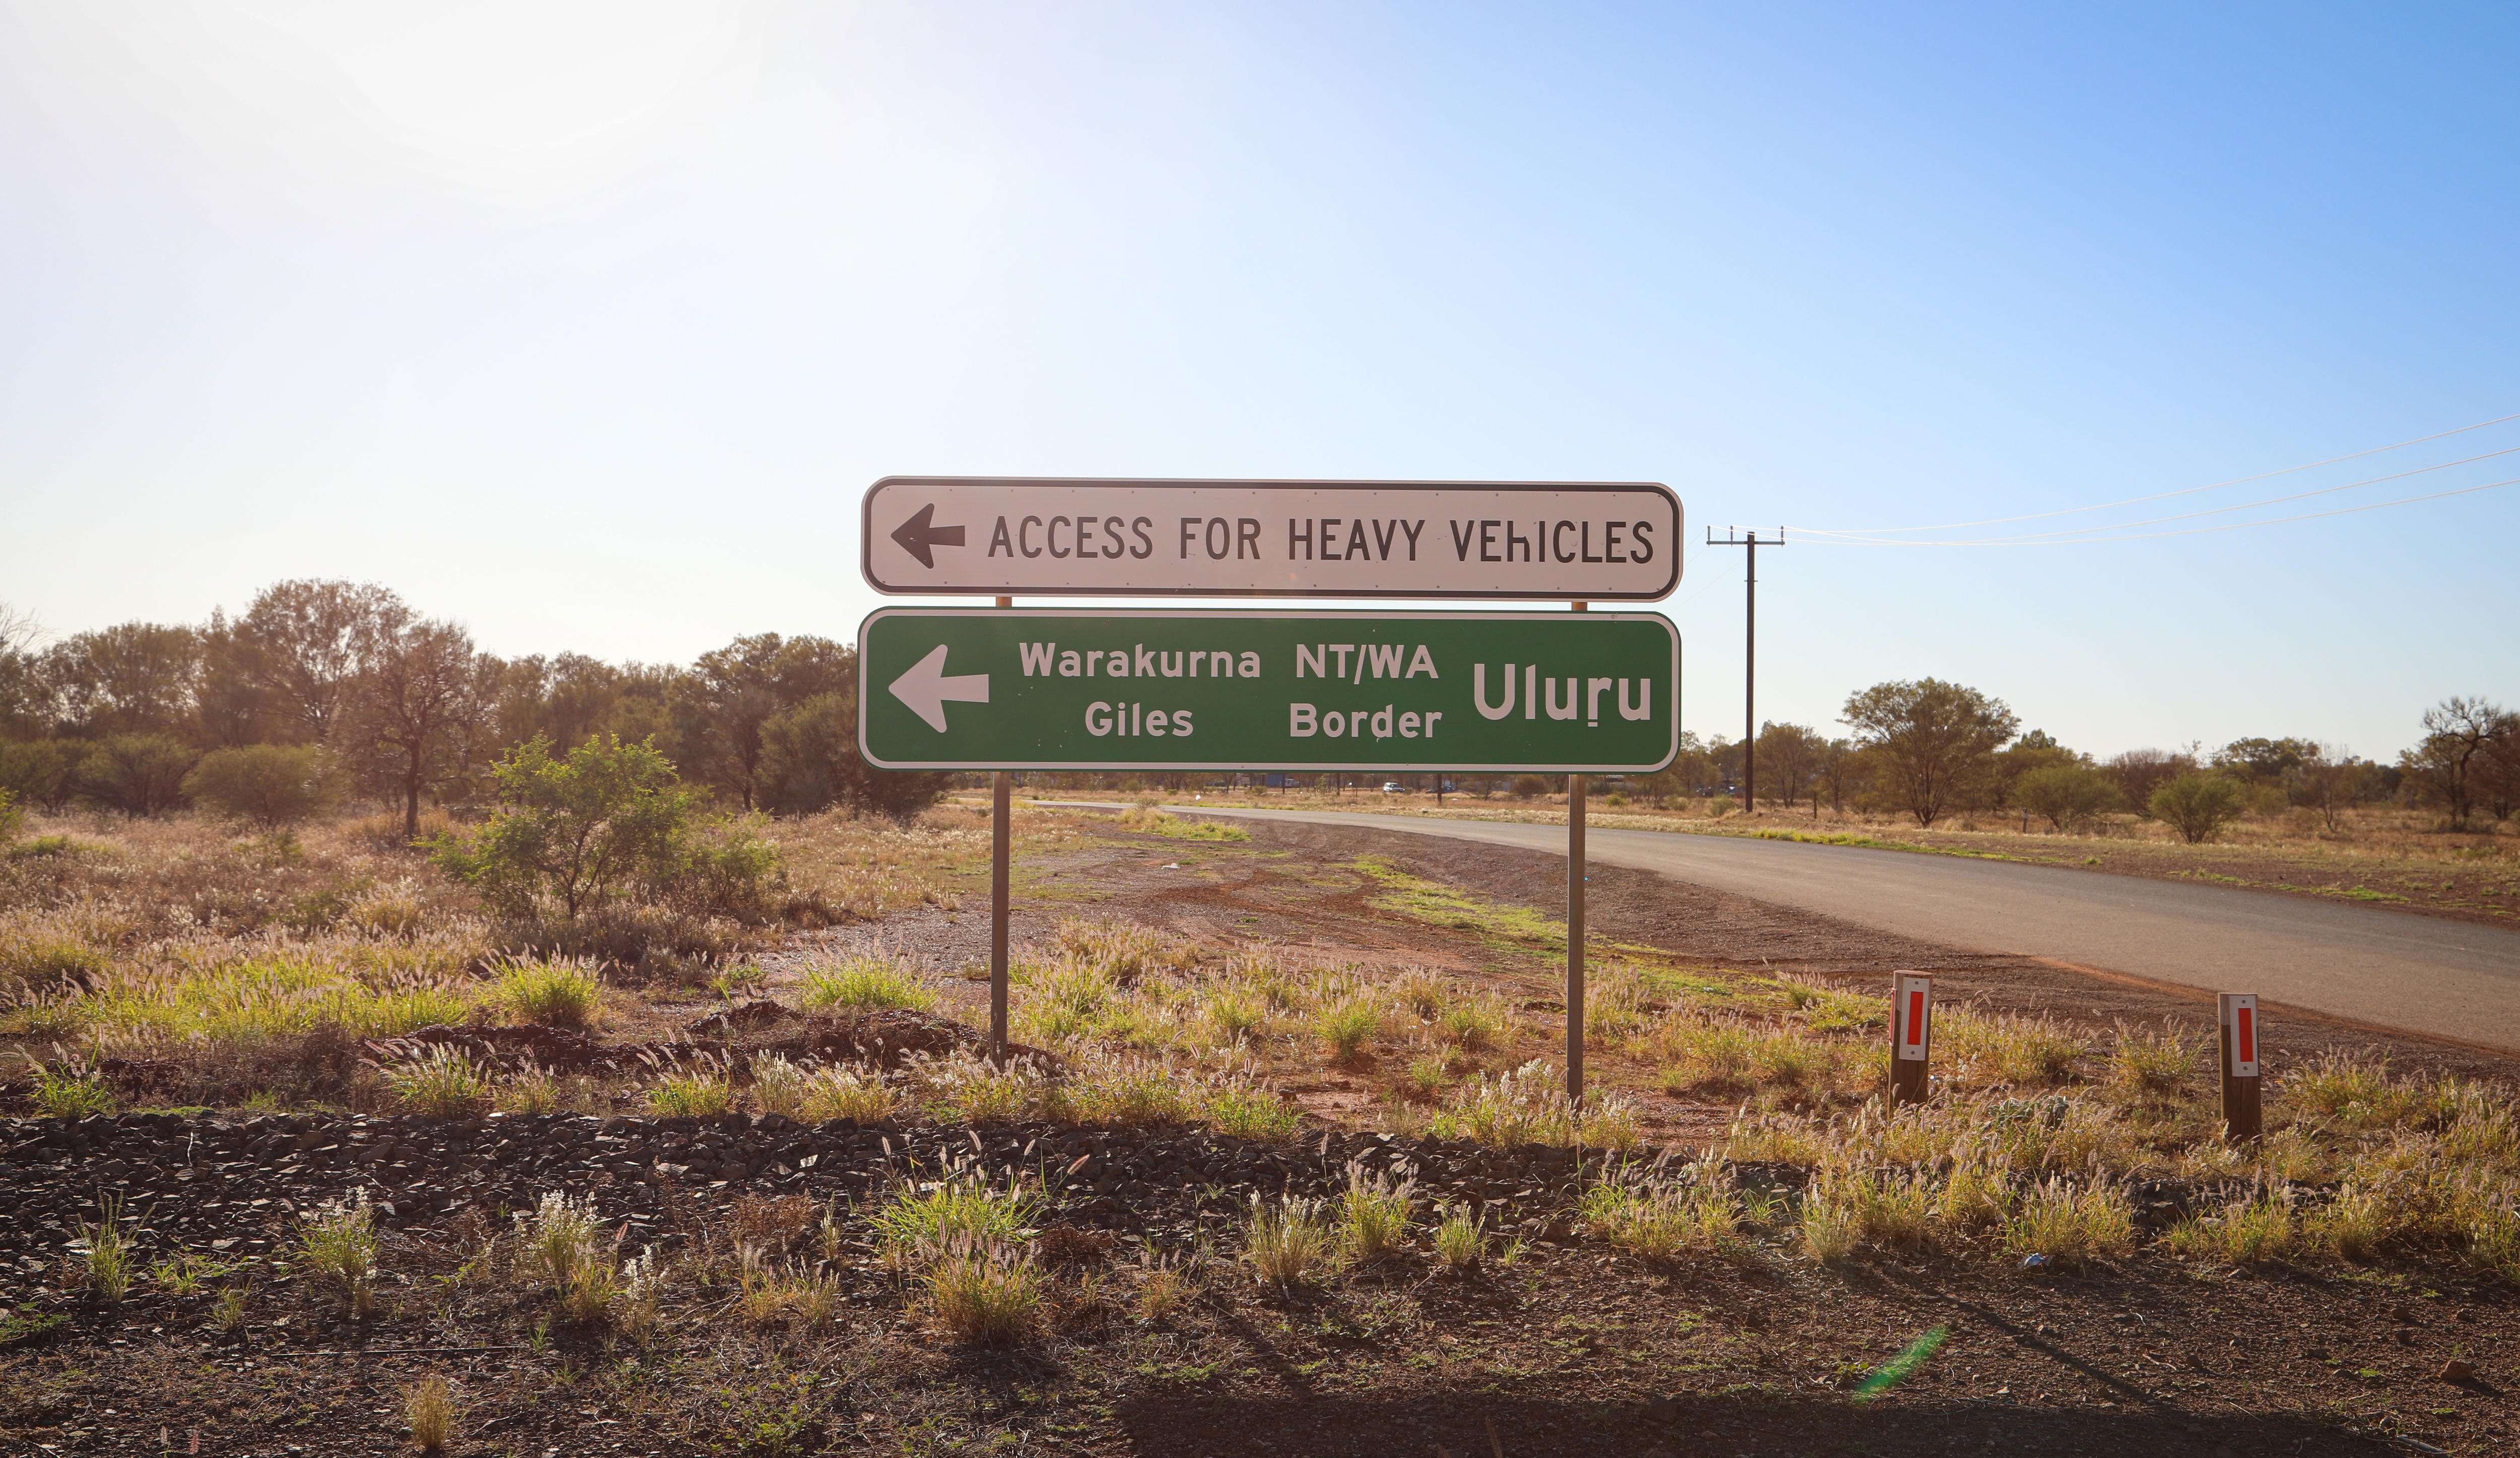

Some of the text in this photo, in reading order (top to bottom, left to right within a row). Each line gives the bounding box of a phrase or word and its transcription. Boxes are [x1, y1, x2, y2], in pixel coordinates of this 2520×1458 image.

[987, 515, 1153, 560] ACCESS
[1180, 517, 1261, 560] FOR
[1289, 518, 1425, 561] HEAVY
[1019, 642, 1260, 678] Warakurna
[1296, 644, 1439, 685] NT/WA
[1085, 701, 1193, 737] Giles
[1290, 703, 1442, 738] Border
